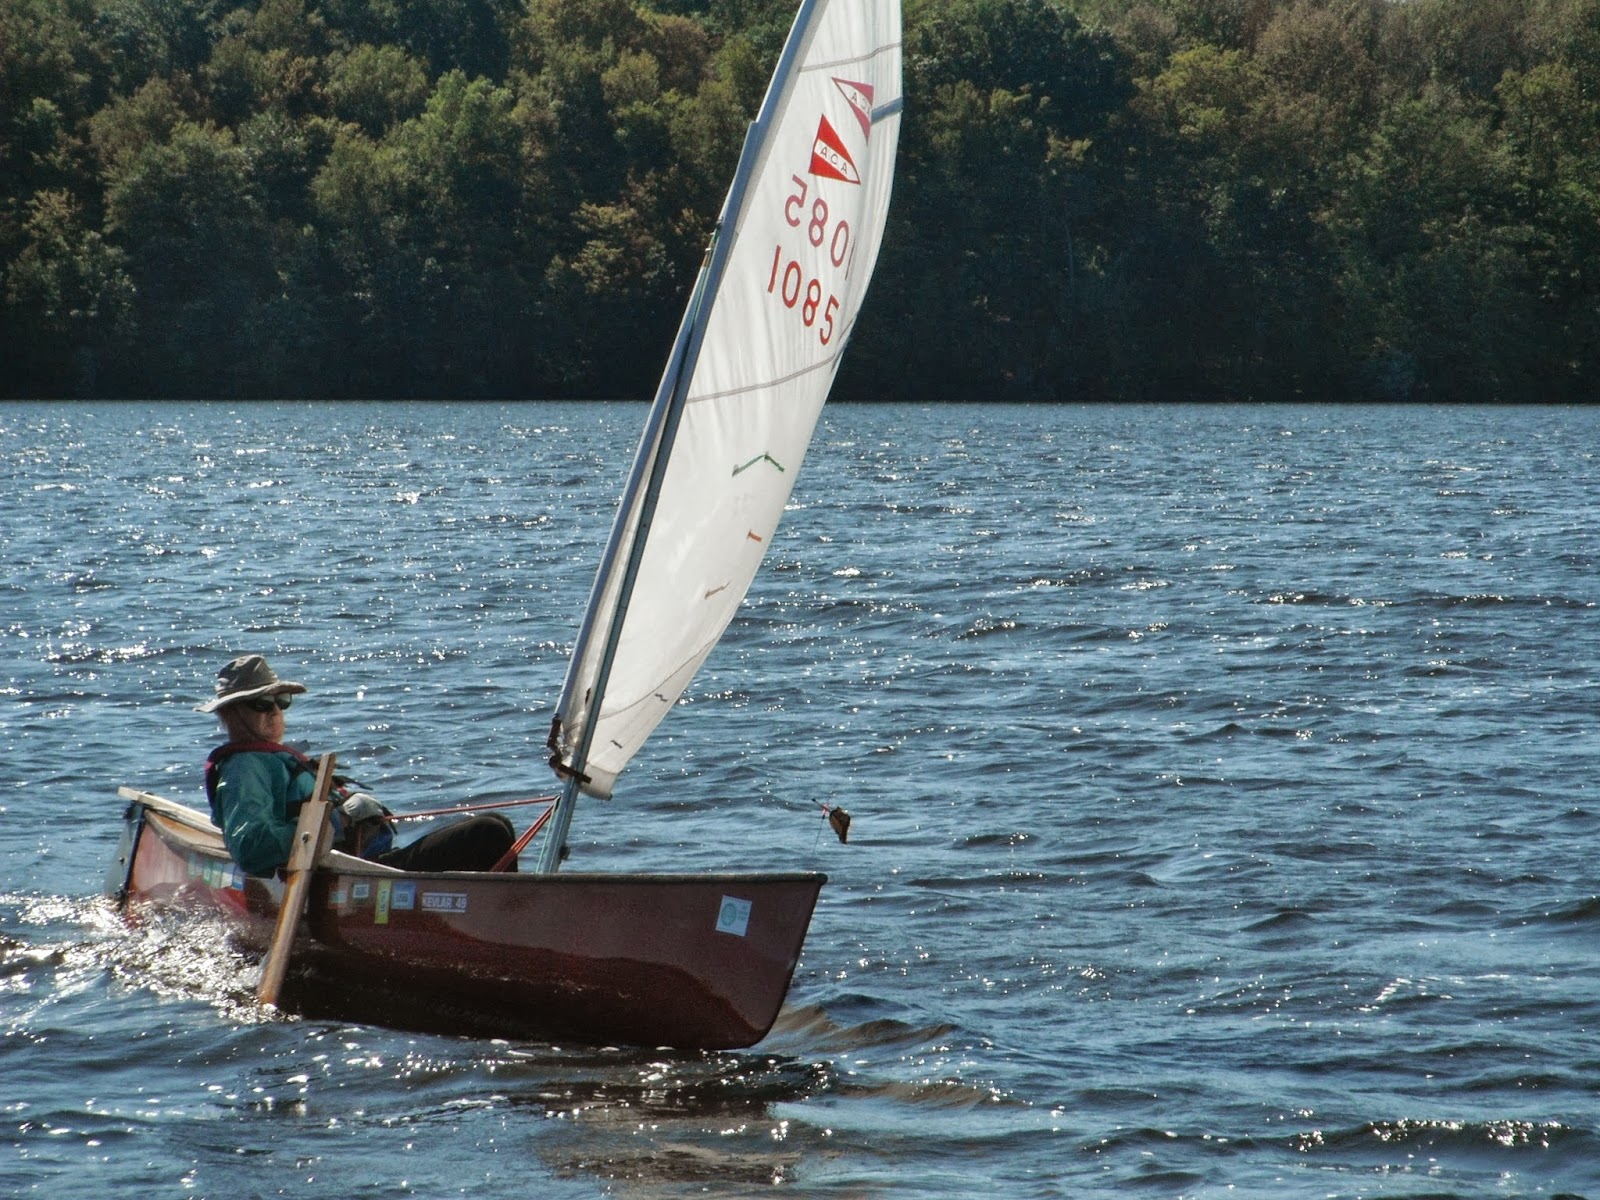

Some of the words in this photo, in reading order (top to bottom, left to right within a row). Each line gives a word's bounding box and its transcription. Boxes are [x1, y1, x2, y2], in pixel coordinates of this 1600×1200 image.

[820, 147, 848, 175] ACA
[767, 245, 840, 345] 1085
[422, 896, 452, 909] KEVLAR
